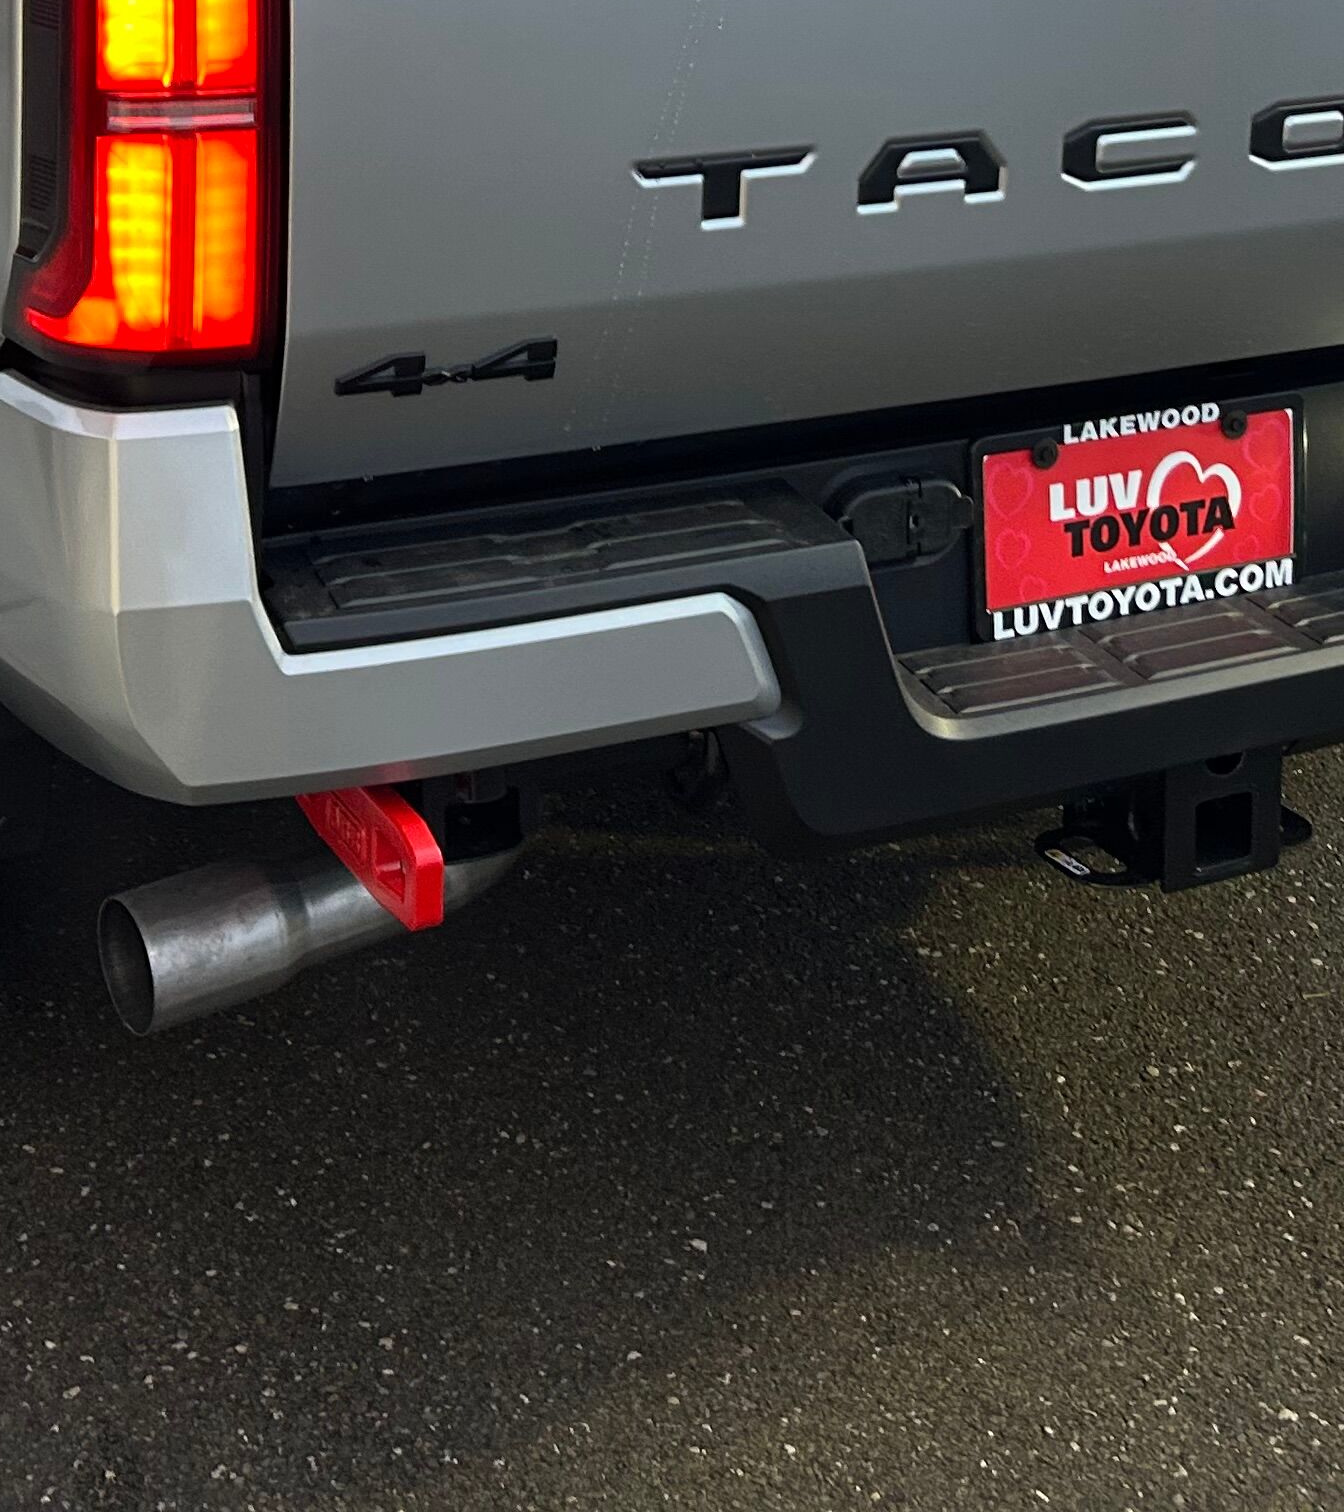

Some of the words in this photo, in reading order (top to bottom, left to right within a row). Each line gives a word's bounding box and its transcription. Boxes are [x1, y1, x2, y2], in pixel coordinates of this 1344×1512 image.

[1063, 402, 1221, 445] LAKEWOOD
[1048, 468, 1143, 522] LUV
[1064, 494, 1236, 558] TOYOTA
[1103, 551, 1178, 574] LAKEWOOD
[992, 558, 1294, 641] LUVTOYOTA.COM
